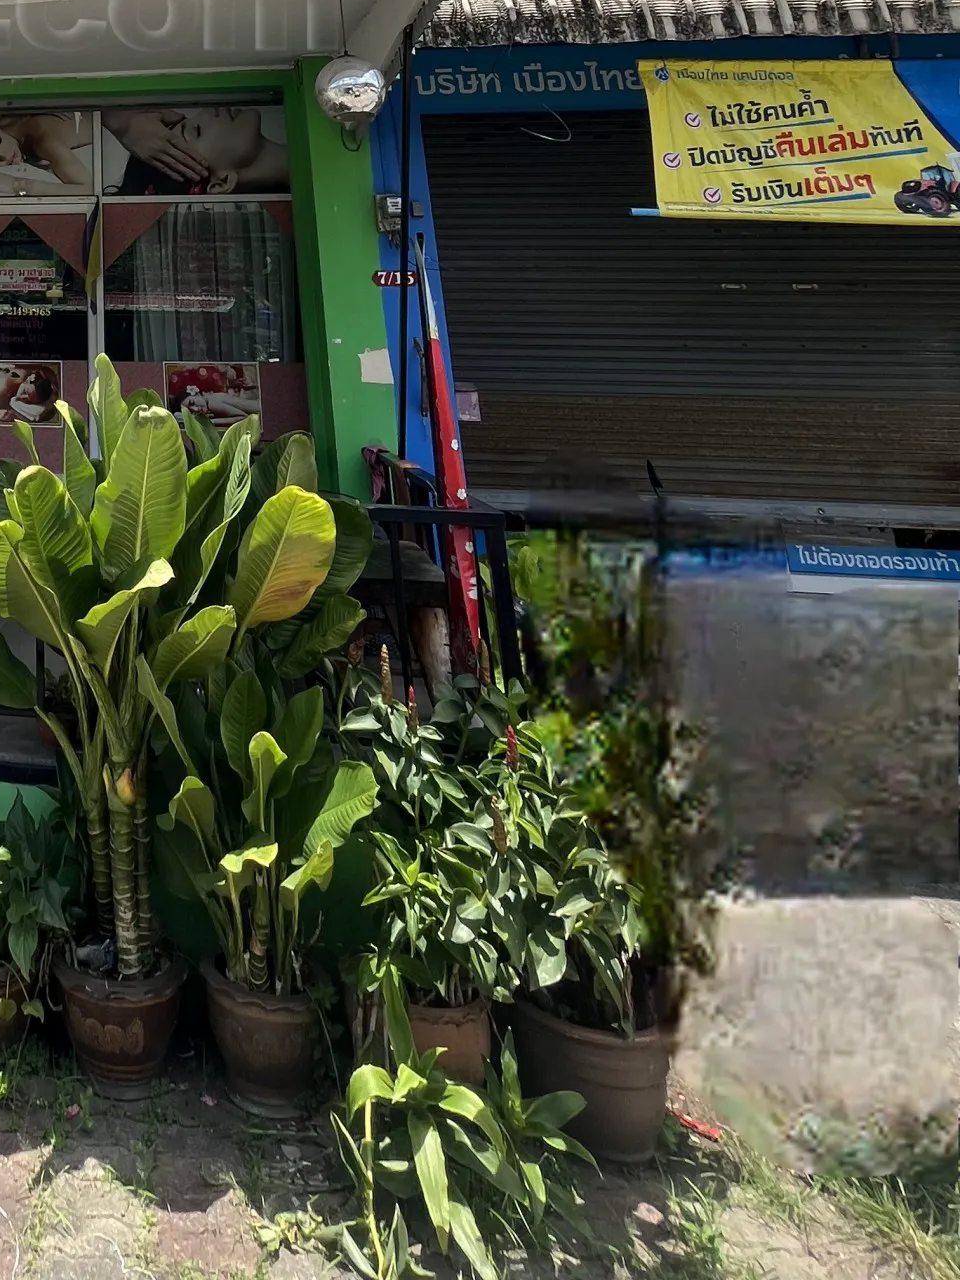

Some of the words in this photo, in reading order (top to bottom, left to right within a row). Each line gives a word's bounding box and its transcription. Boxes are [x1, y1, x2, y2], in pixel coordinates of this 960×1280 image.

[414, 65, 502, 96] บริษัท
[513, 61, 646, 94] เมืองไทย
[707, 88, 829, 127] ไม่ใช้คนค้ำ
[687, 119, 924, 167] ปิดบัญชีคืนเล่มทันที
[732, 166, 876, 204] รับเงินเต็มๆ
[795, 544, 960, 572] ไม่ต้องถอดรองเท้า
